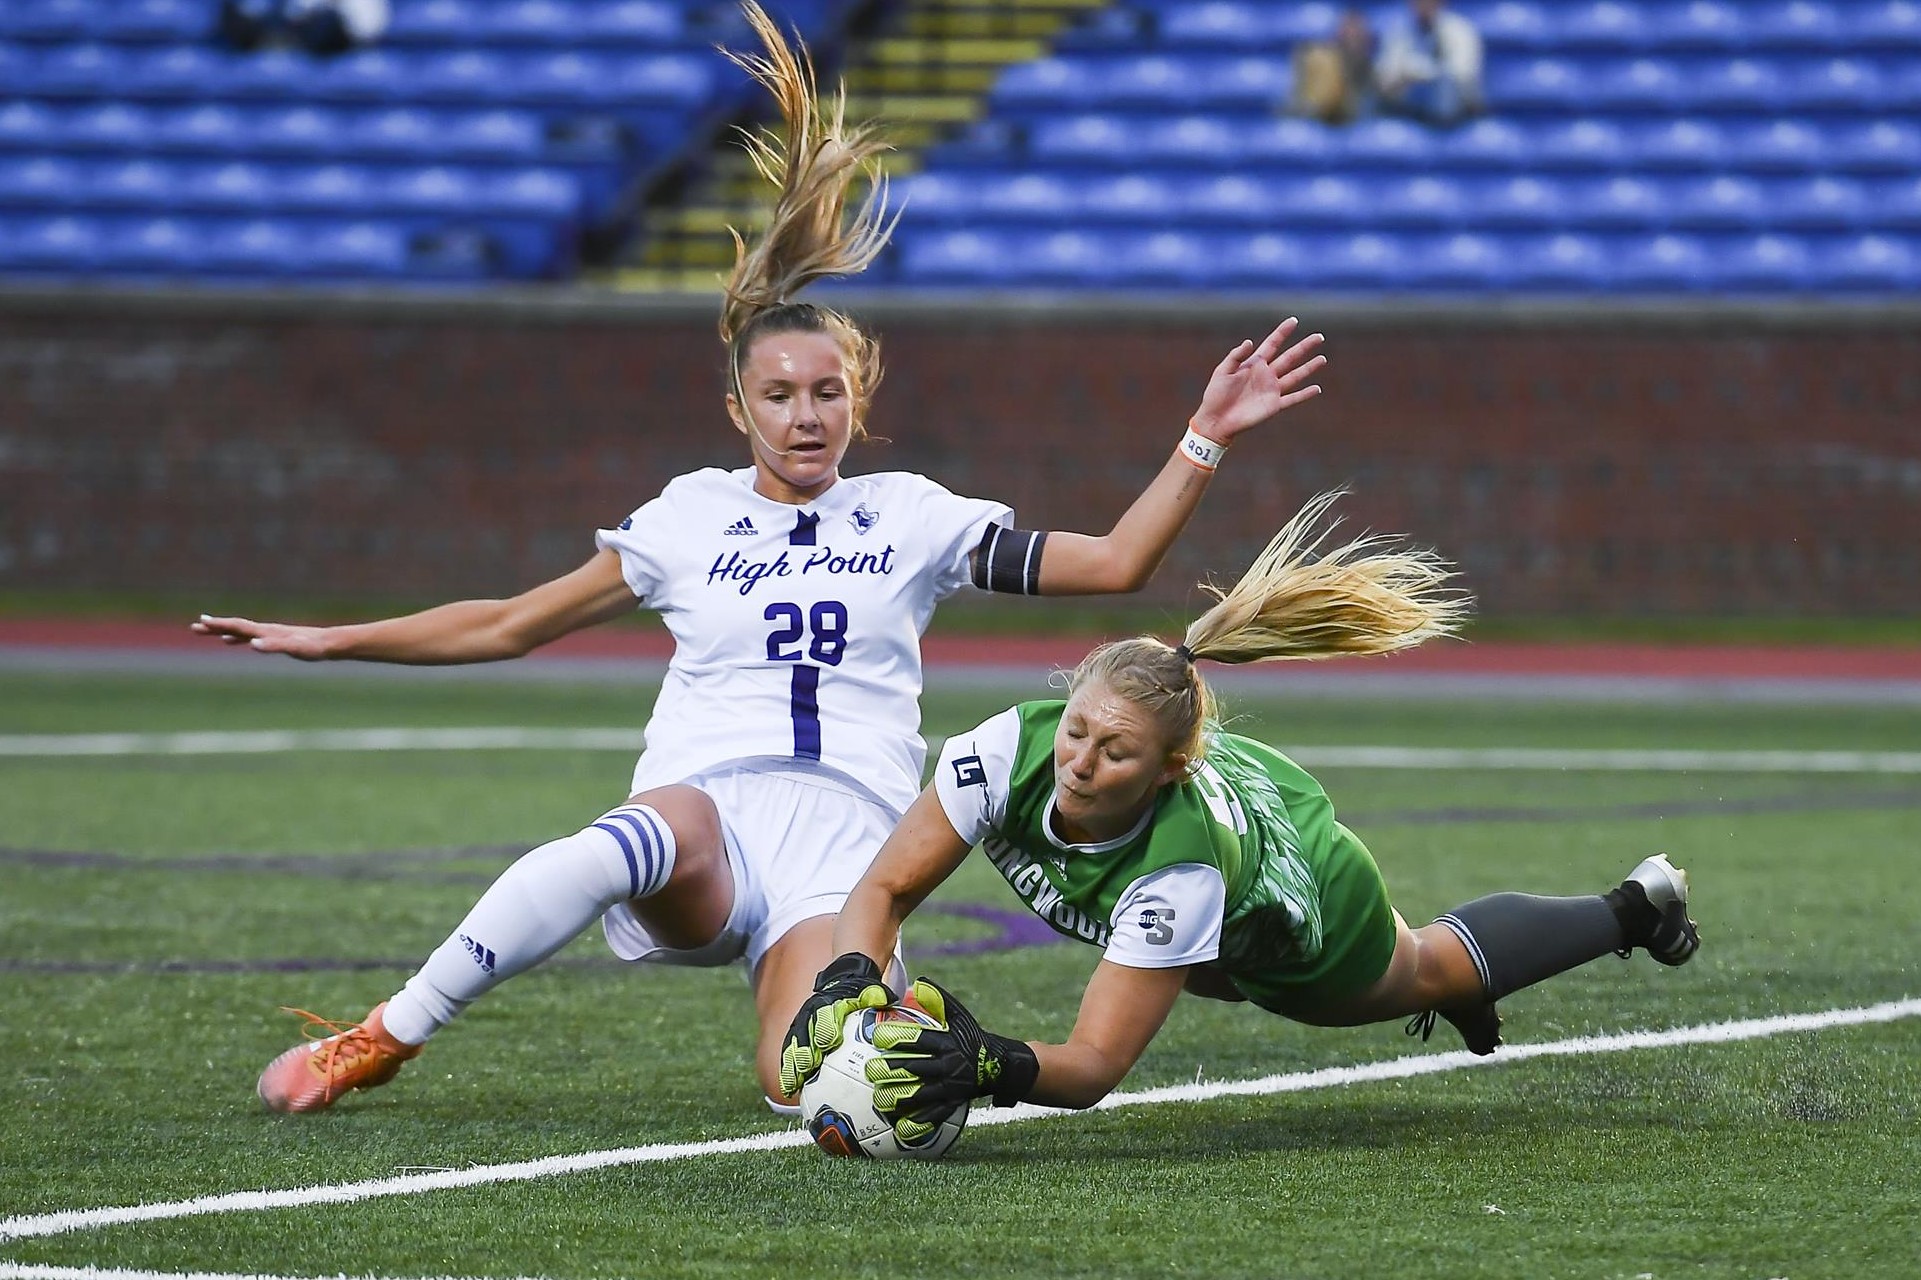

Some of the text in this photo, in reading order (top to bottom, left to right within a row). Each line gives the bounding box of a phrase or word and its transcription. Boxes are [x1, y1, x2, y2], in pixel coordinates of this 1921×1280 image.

[707, 544, 895, 596] High Point
[763, 600, 848, 667] 28
